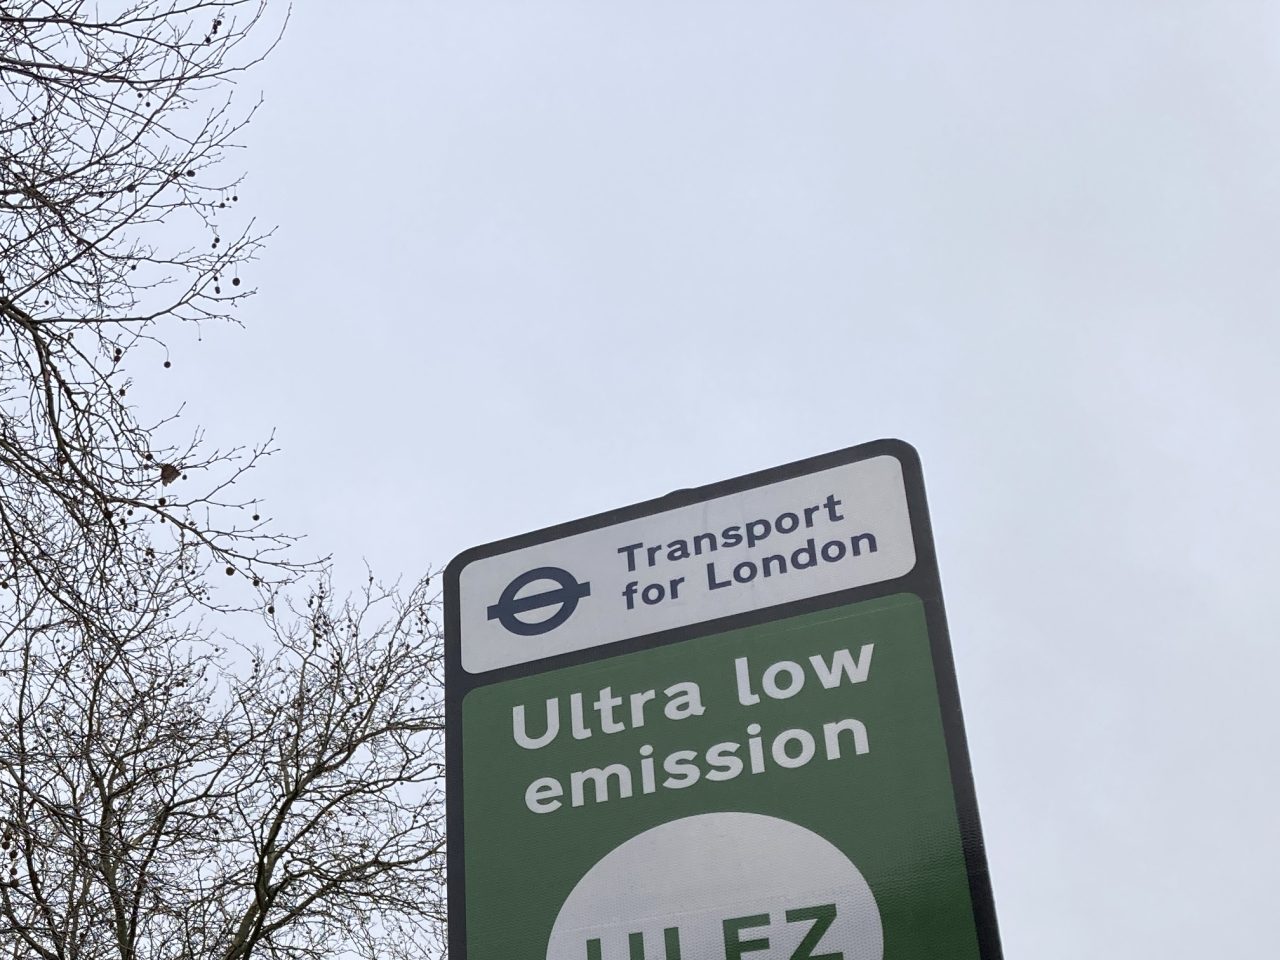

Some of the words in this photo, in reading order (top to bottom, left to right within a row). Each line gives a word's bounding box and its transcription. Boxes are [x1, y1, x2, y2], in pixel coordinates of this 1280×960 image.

[617, 493, 845, 573] Transport
[621, 576, 685, 611] for
[706, 532, 878, 591] London
[512, 681, 706, 750] Ultra
[734, 643, 875, 706] low
[524, 718, 870, 814] emission
